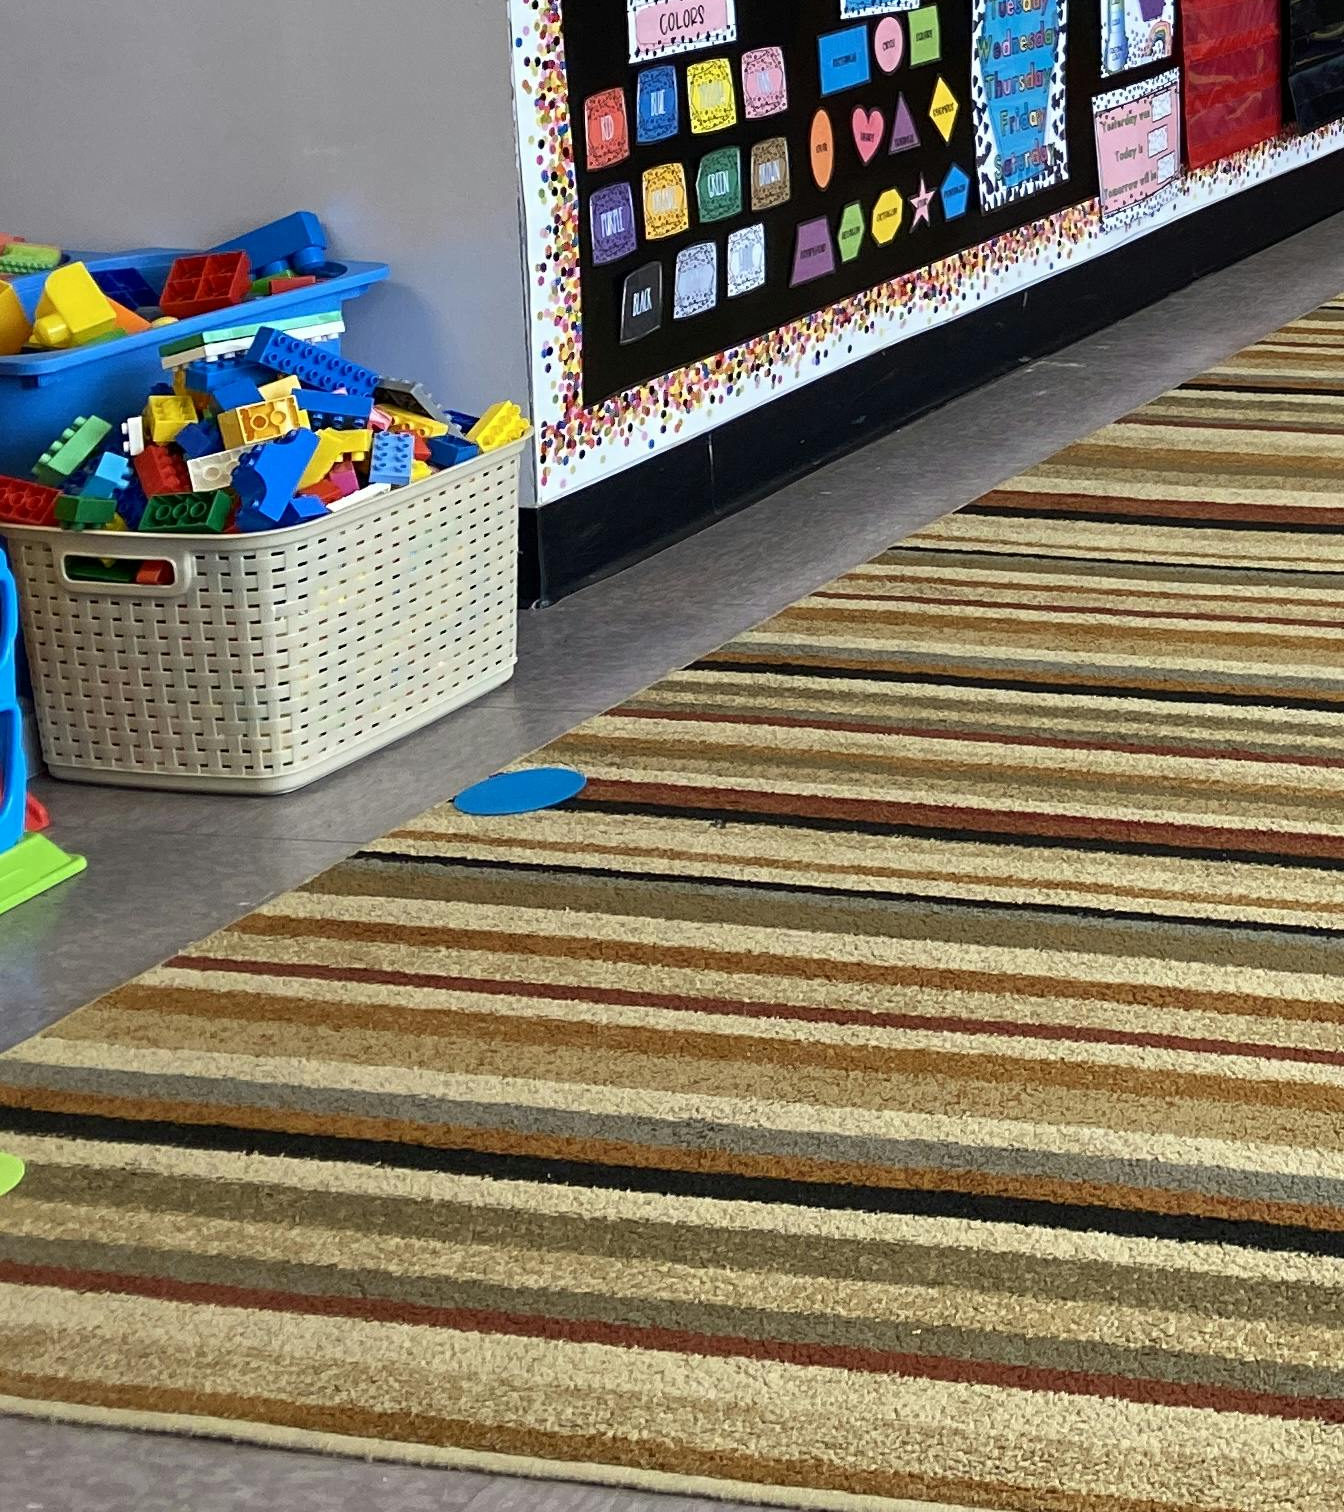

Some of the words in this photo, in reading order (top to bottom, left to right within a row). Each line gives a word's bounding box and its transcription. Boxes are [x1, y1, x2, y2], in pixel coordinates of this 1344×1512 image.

[659, 5, 706, 35] COLORS
[977, 21, 1059, 63] Wednesday
[984, 62, 1053, 101] Thursday
[1000, 102, 1047, 137] Friday
[994, 138, 1055, 182] Saturday
